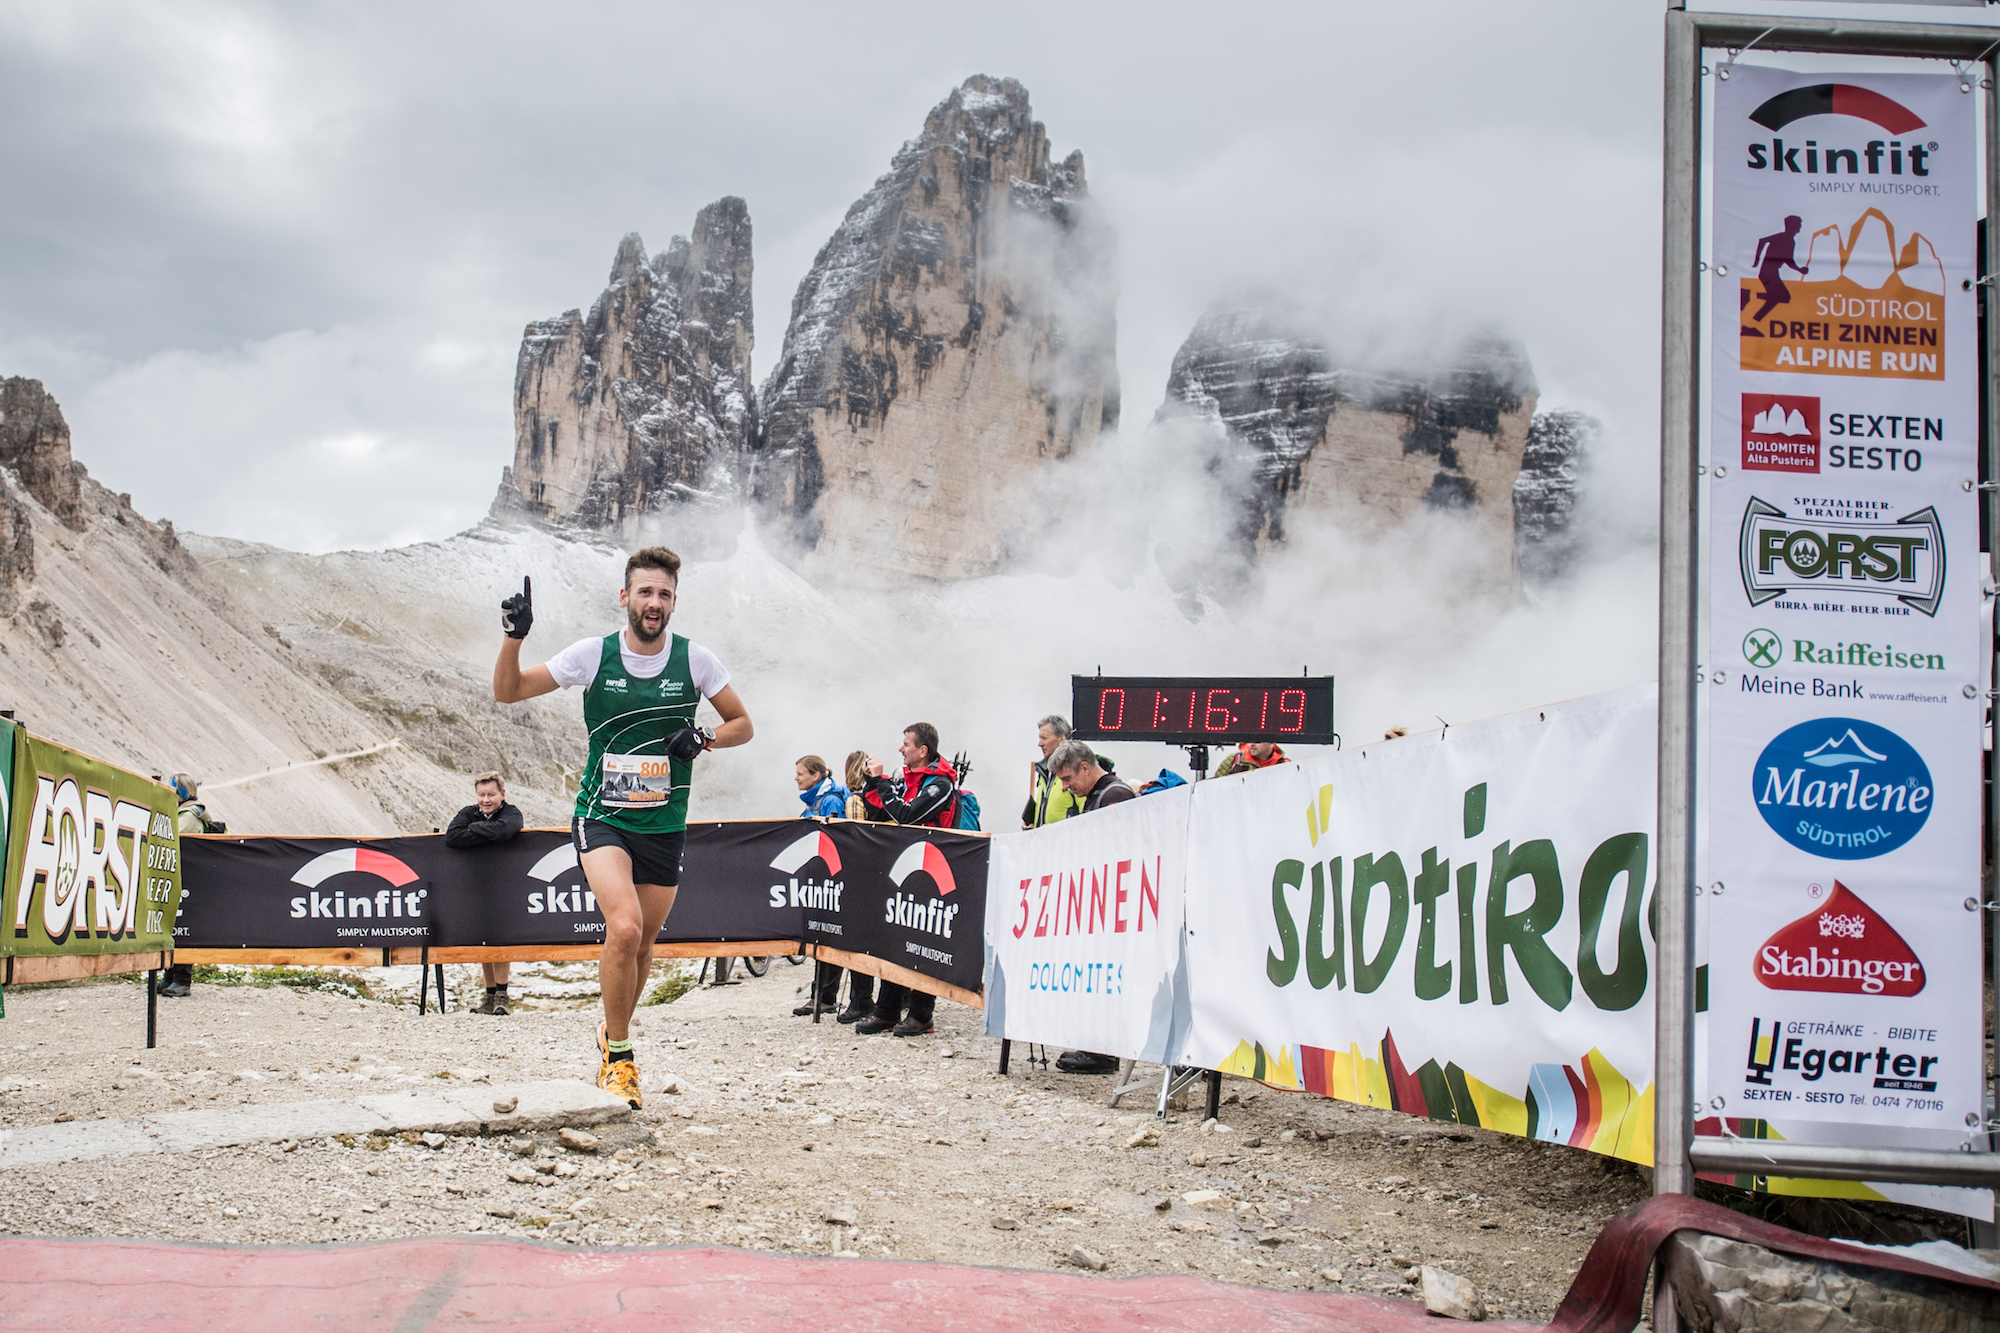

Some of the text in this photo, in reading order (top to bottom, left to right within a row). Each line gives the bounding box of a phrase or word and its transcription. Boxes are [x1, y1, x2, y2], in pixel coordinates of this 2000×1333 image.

[1809, 181, 1941, 197] SIMPLY MULTISPORT.
[1816, 293, 1938, 321] SÜDTIROL
[1769, 320, 1937, 346] DREI ZINNEN
[1776, 346, 1937, 373] ALPINE RUN
[1829, 412, 1943, 441] SEXTEN
[1747, 440, 1816, 455] DOLOMITEN
[1747, 453, 1815, 467] Alta Pusteria
[1829, 445, 1922, 472] SESTO
[1804, 508, 1879, 520] BRAUEREI
[1758, 528, 1928, 583] FORST
[1792, 639, 1946, 670] Raiffeisen
[1741, 674, 1948, 704] Meine Bank www.raiffeisen.it
[640, 761, 669, 779] 800
[1759, 767, 1930, 814] Marlene
[151, 811, 175, 842] BIRRA
[1796, 820, 1892, 848] SÜDTIROL
[15, 770, 152, 946] FORST
[1266, 782, 1656, 1014] süDtiRO
[336, 926, 430, 937] SIMPLY MULTISPORT.
[573, 922, 606, 933] SIMPLY
[1761, 945, 1920, 993] Stabinger
[1787, 1021, 1938, 1042] GETRÄNKE BIBITE
[1783, 1038, 1938, 1081] Egarter
[1903, 1082, 1923, 1090] 1946
[1743, 1089, 1944, 1111] SEXTEN SESTO Tel. 0474 710116
